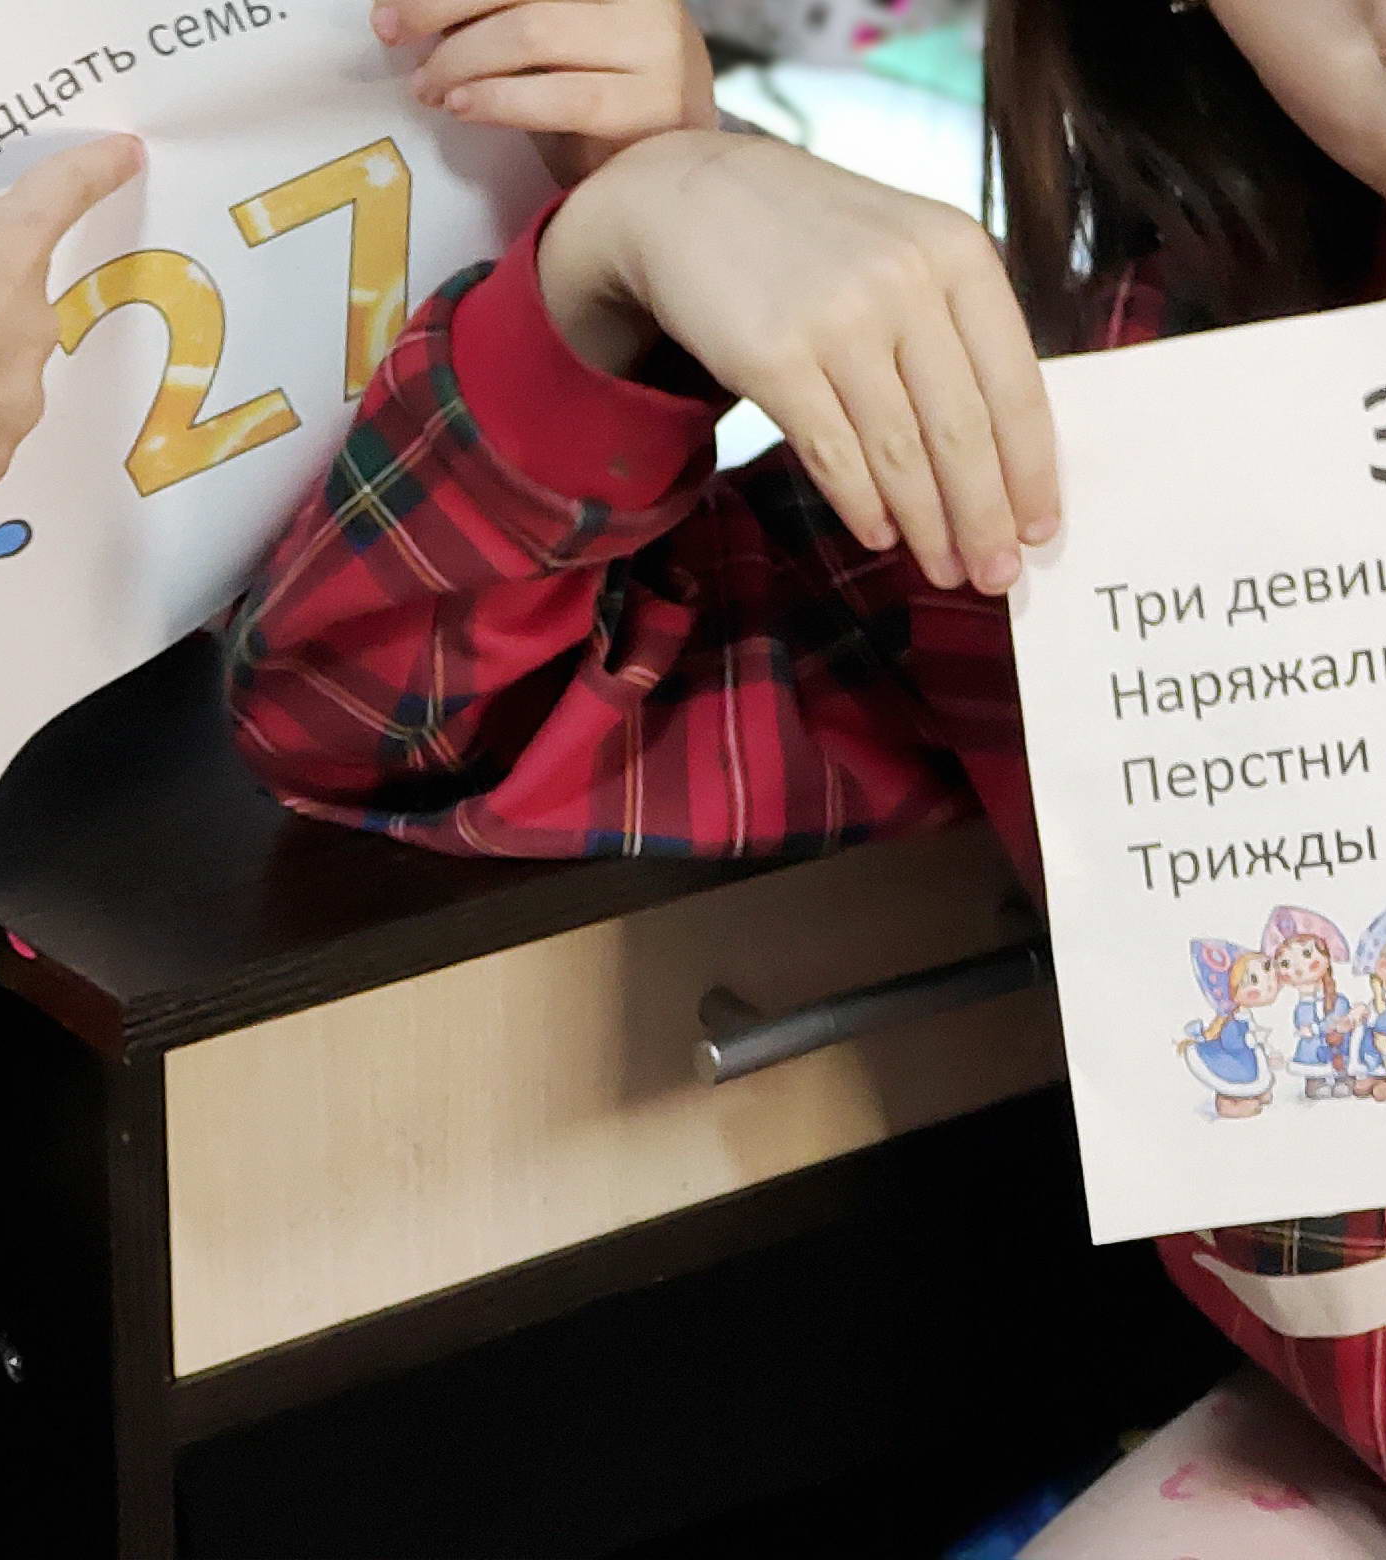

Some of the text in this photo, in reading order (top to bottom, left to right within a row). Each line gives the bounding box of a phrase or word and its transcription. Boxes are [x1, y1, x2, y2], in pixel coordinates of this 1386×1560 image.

[53, 135, 411, 497] 27
[1093, 582, 1207, 642] Три
[1120, 736, 1371, 808] Перстни
[1126, 824, 1379, 900] Трижды
